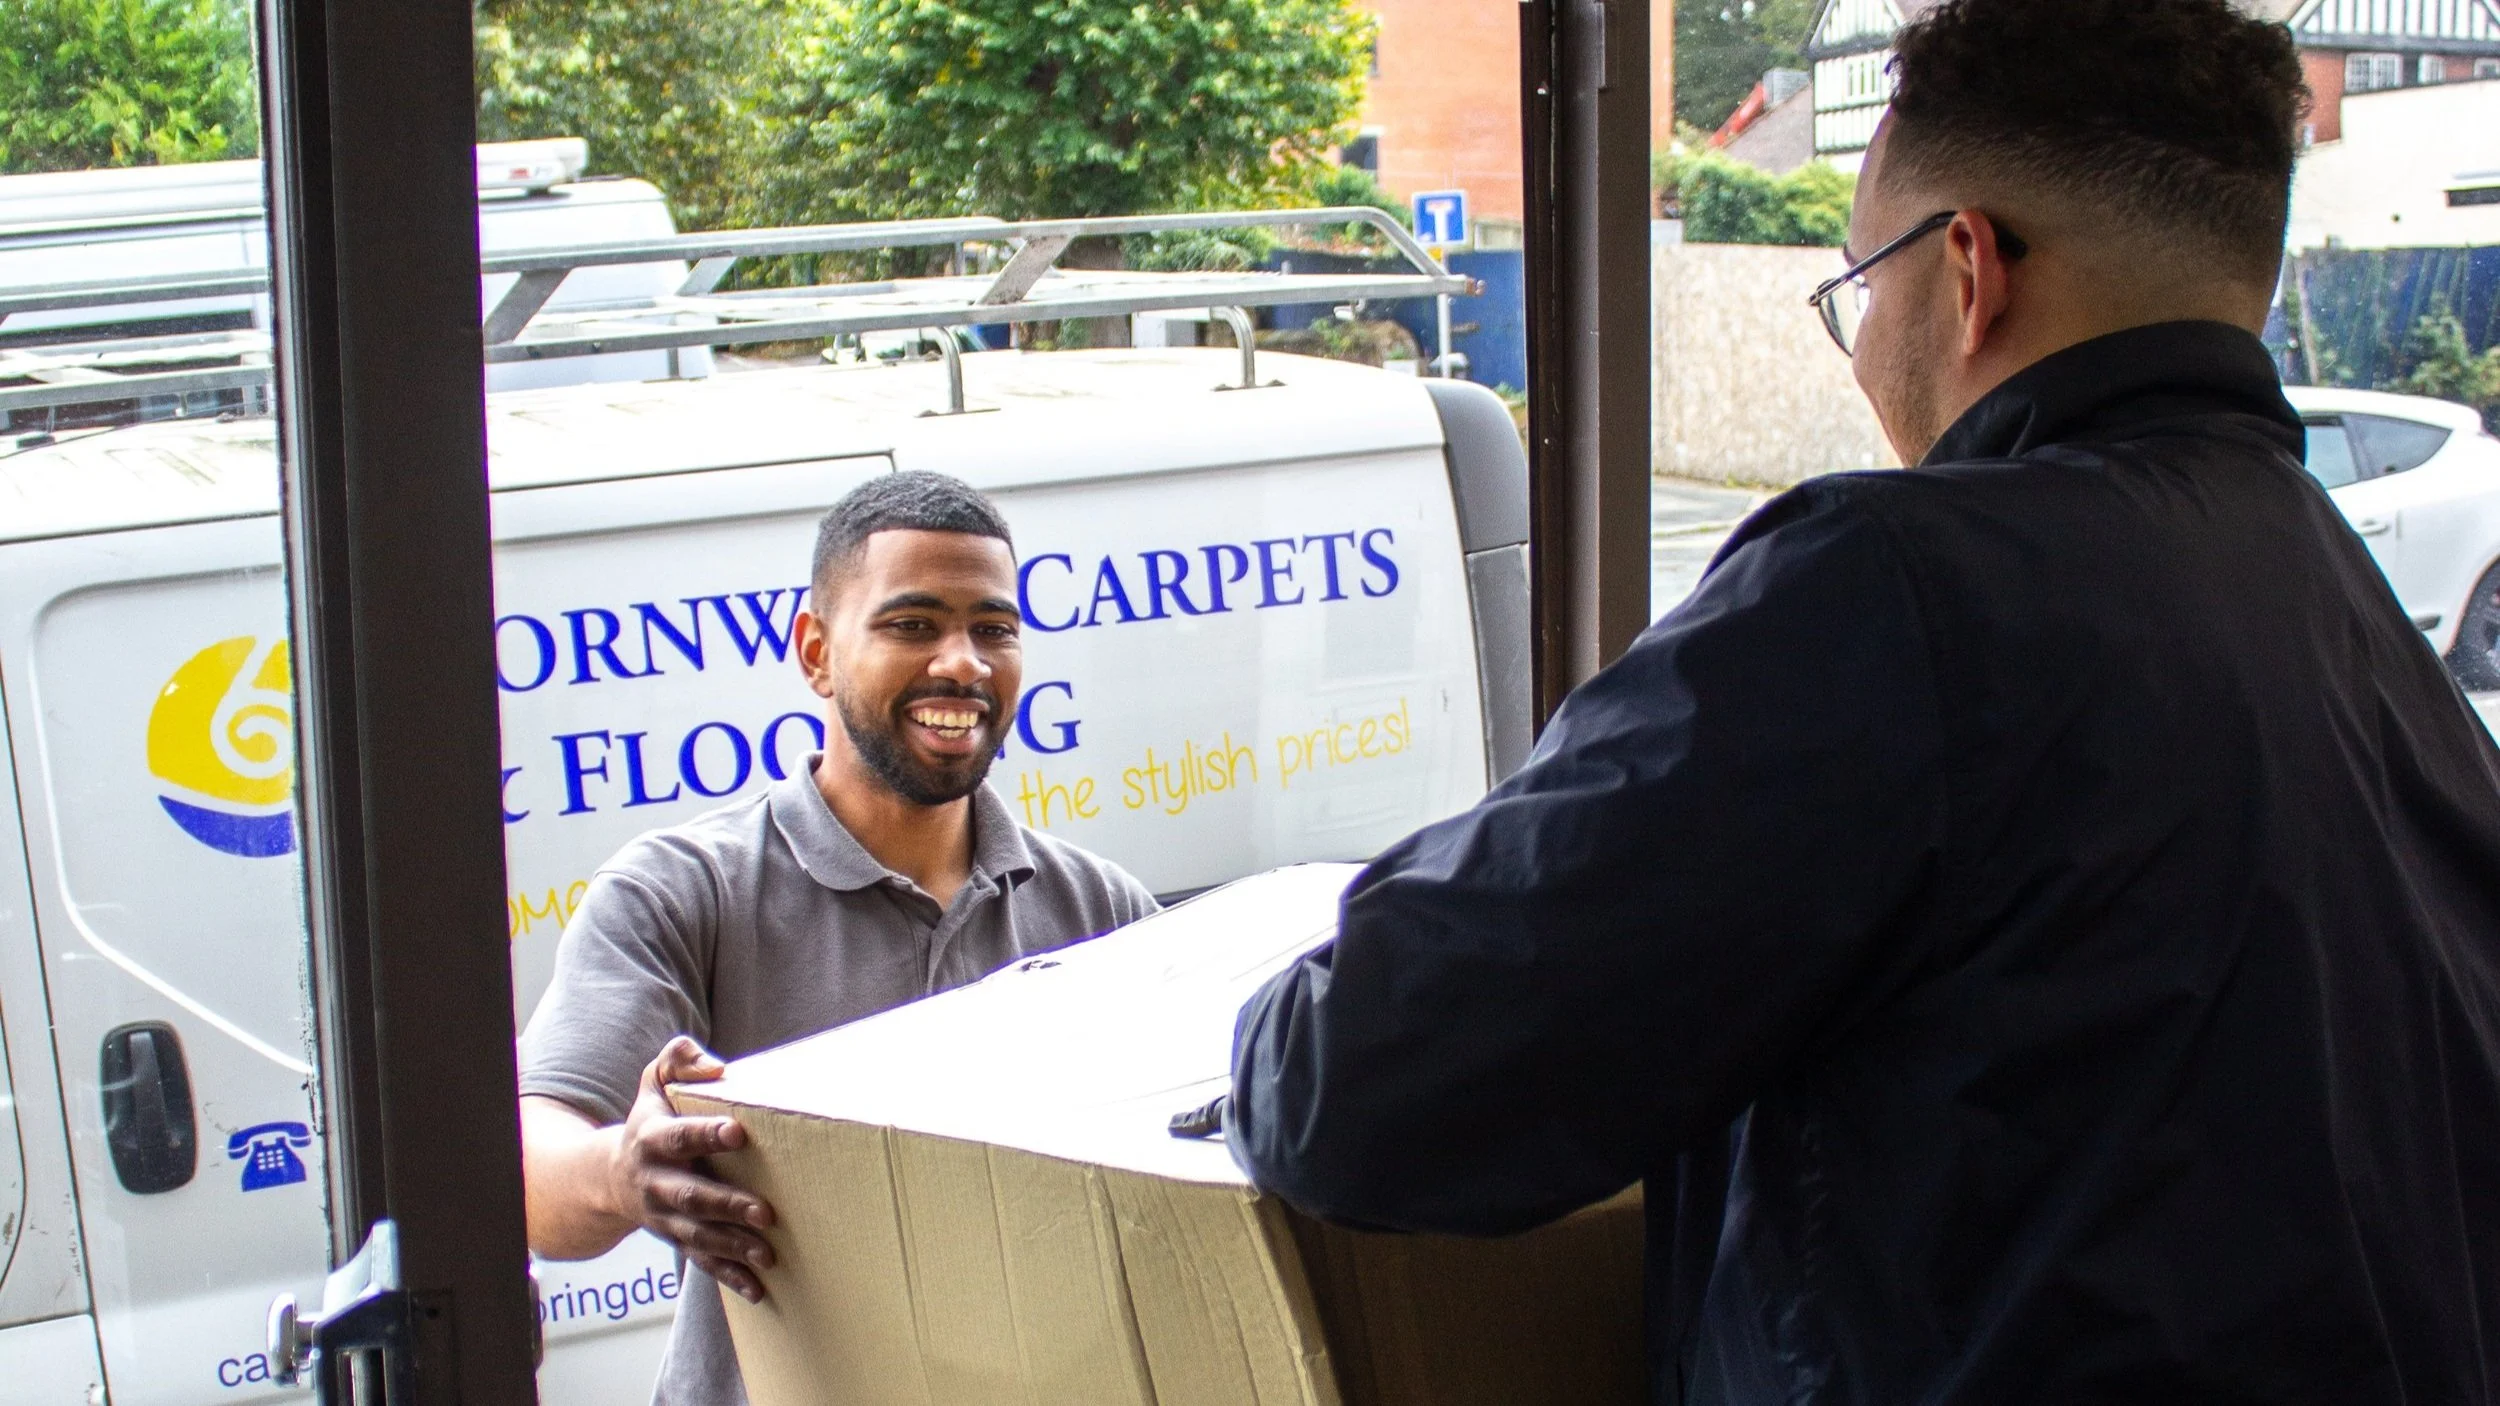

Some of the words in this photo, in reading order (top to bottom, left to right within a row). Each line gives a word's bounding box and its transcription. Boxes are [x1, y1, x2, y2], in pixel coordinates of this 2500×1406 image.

[1016, 527, 1400, 634] CARPETS
[552, 681, 1082, 817] FLOOG
[1016, 770, 1102, 830] the
[1122, 731, 1260, 817] stylish
[1276, 695, 1413, 790] prices!
